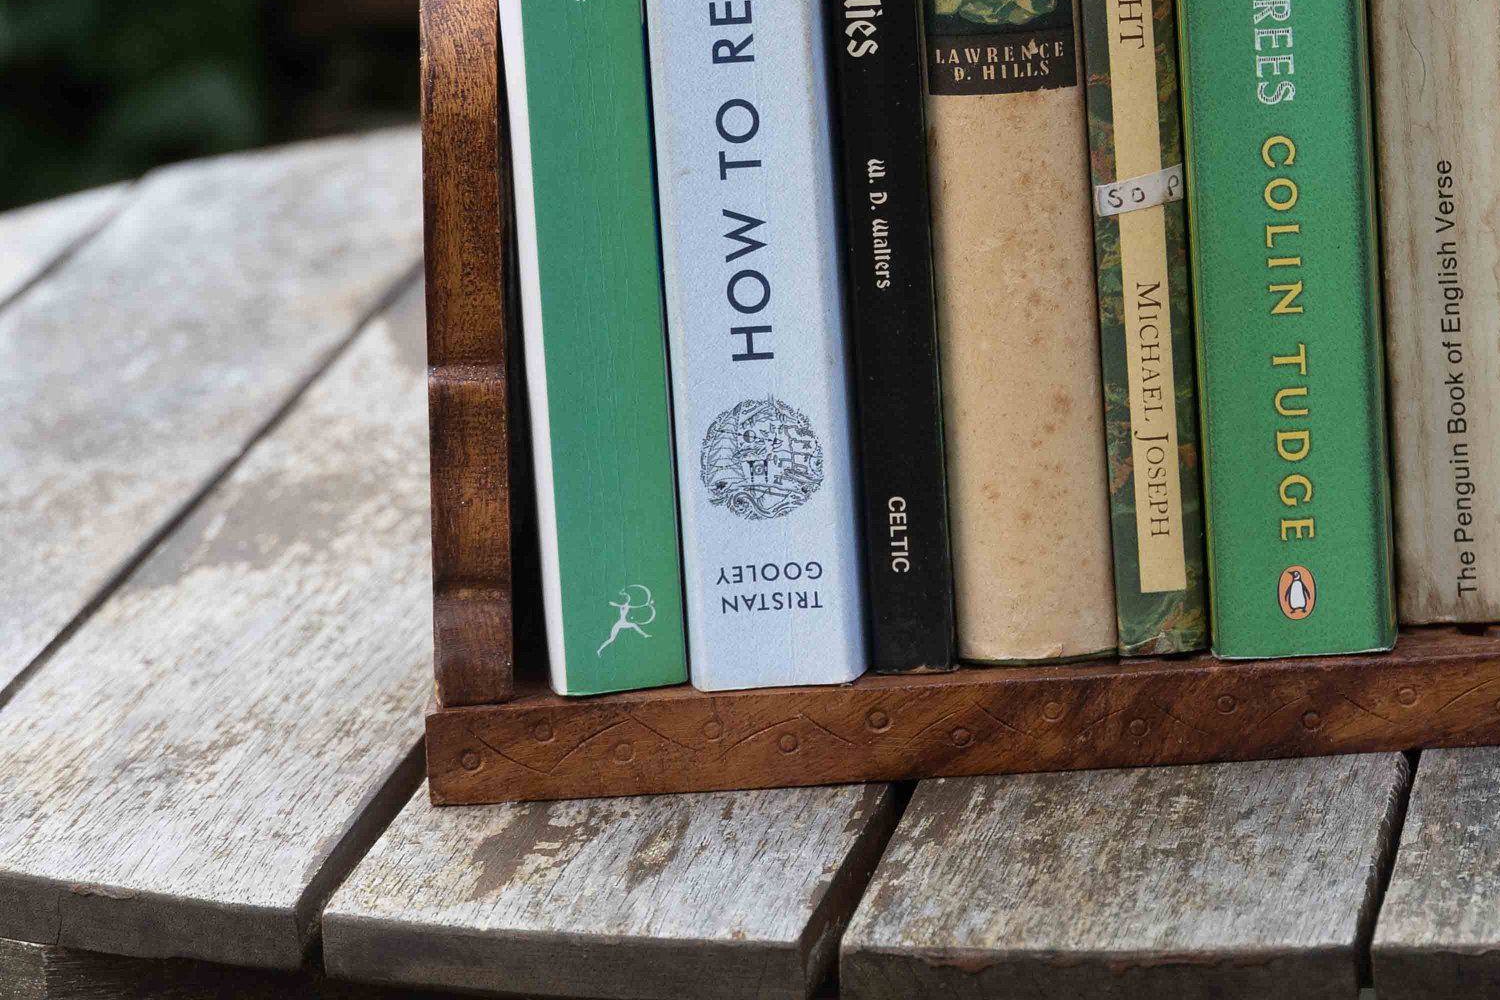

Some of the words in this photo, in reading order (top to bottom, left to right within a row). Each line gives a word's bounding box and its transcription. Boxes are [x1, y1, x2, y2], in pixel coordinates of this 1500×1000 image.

[935, 41, 1064, 64] LAWRENCE
[953, 66, 972, 81] D.
[982, 60, 1050, 80] HILLS
[714, 97, 762, 180] TO
[869, 191, 888, 211] D.
[1261, 135, 1305, 315] COLIN
[1435, 159, 1456, 234] Verse
[721, 208, 775, 362] HOW
[872, 218, 892, 289] Walters
[1438, 242, 1465, 336] English
[1135, 281, 1163, 422] MICHAEL
[1443, 344, 1464, 371] of
[1271, 343, 1317, 541] TUDGE
[1447, 380, 1468, 450] Book
[1134, 430, 1170, 538] JOSEPH
[1450, 458, 1477, 544] Penguin
[887, 495, 910, 573] CELTIC
[716, 561, 824, 583] GOOLEY
[721, 592, 824, 614] TRISTAN
[1457, 550, 1478, 599] The
